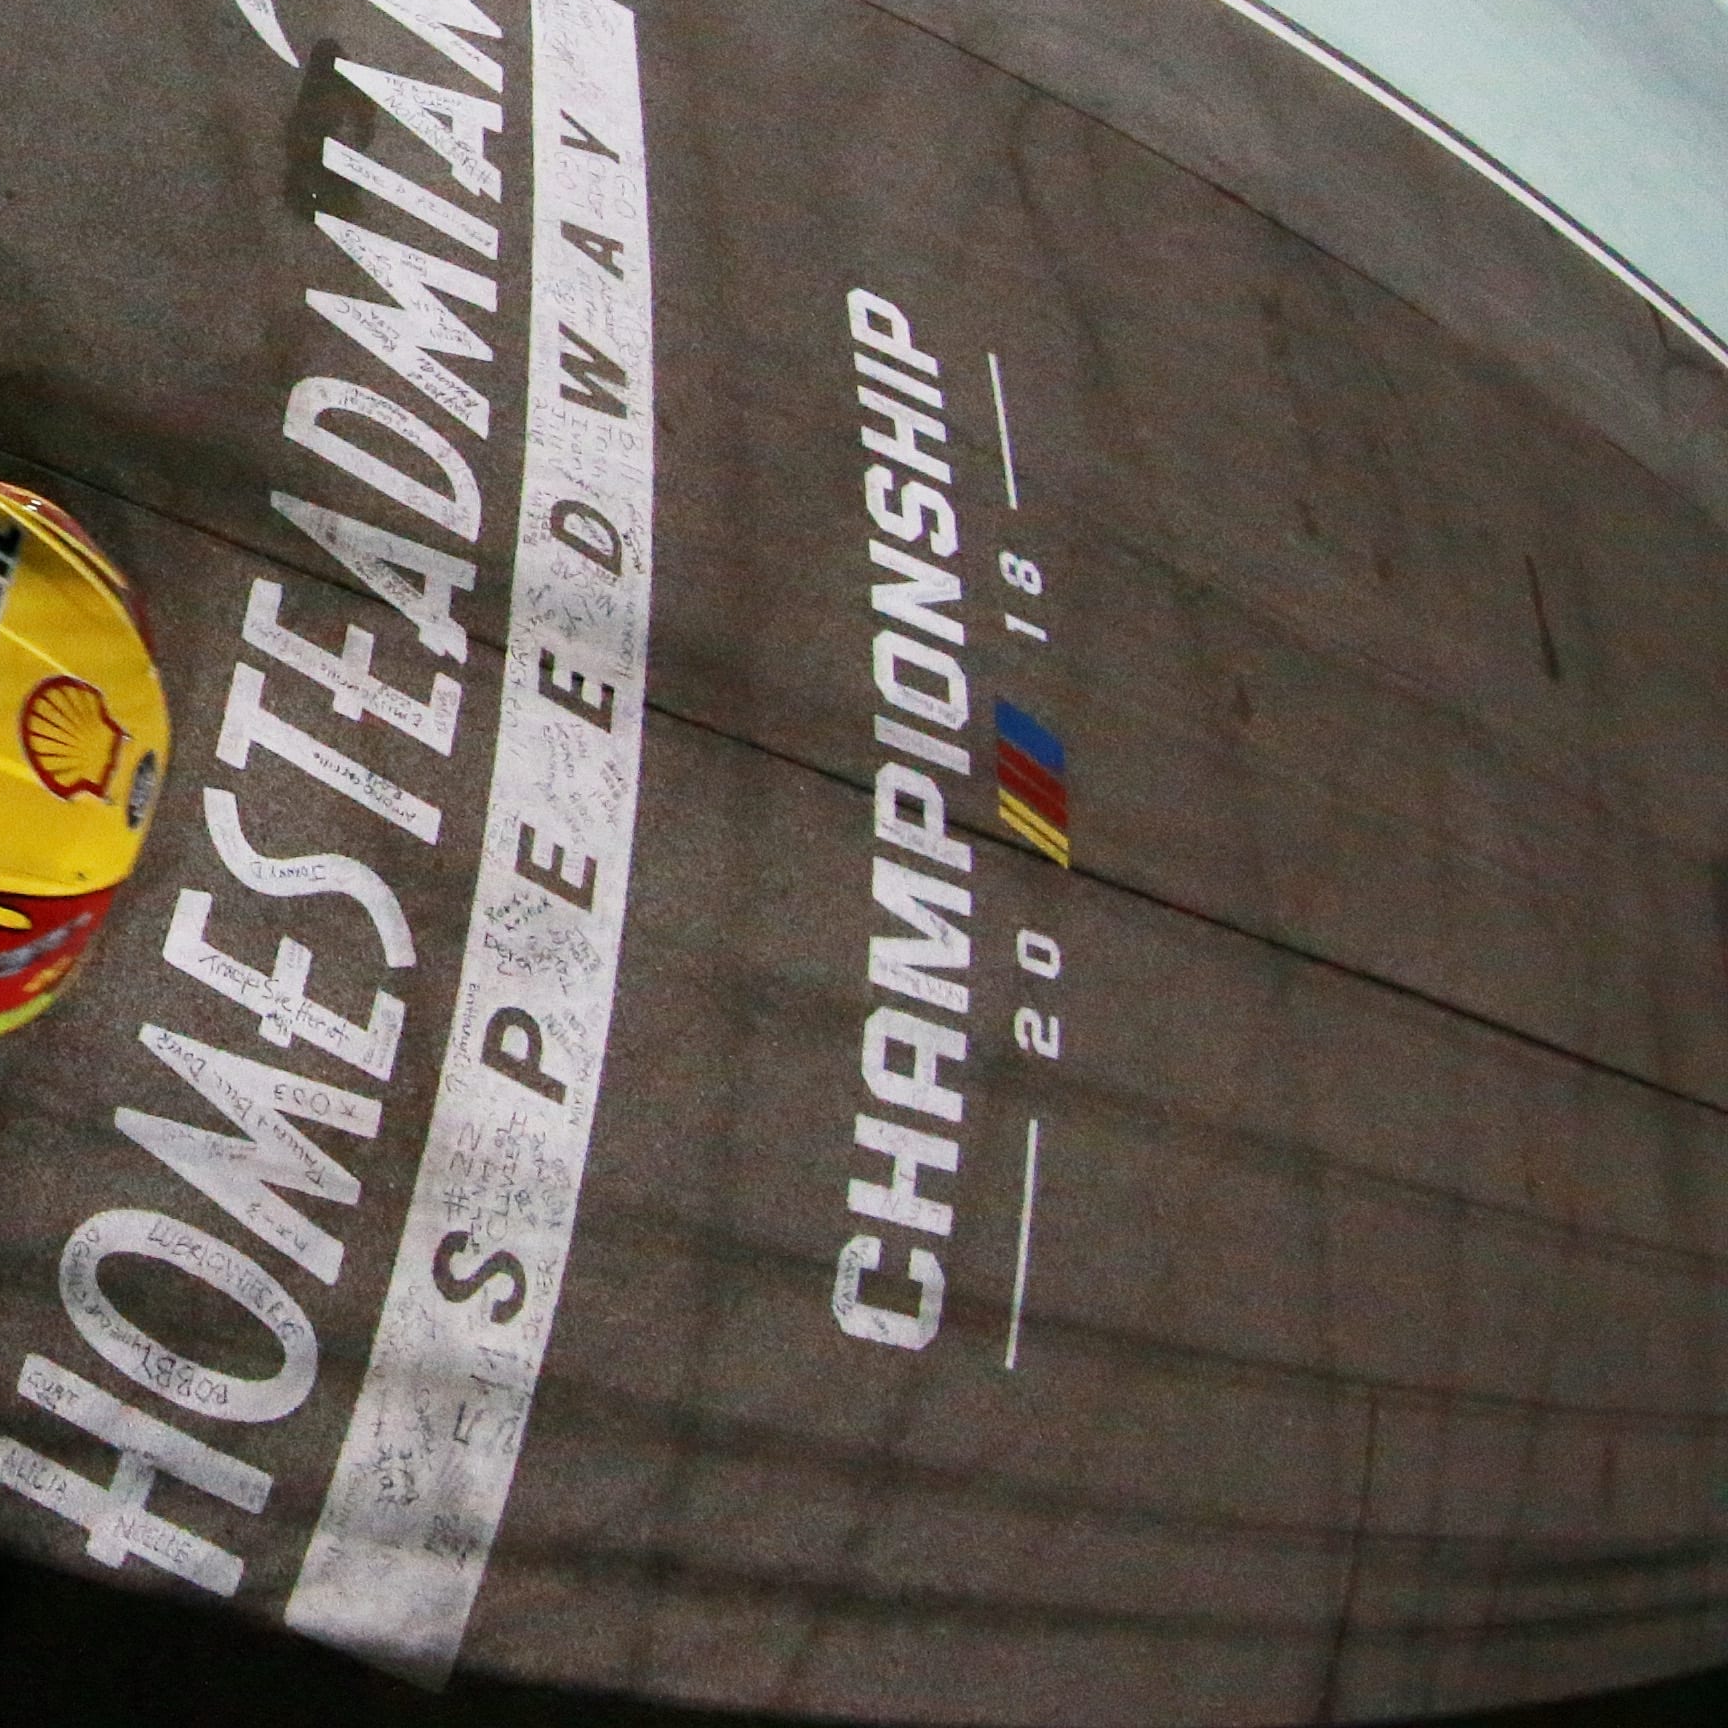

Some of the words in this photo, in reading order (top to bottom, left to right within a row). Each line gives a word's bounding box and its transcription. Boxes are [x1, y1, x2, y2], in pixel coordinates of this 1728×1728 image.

[996, 546, 1045, 643] 18
[432, 107, 628, 1324] SPEEDWAY
[832, 284, 973, 1351] CHAMPIONSHIP
[1013, 924, 1064, 1060] 20
[140, 1347, 229, 1407] BOBBY
